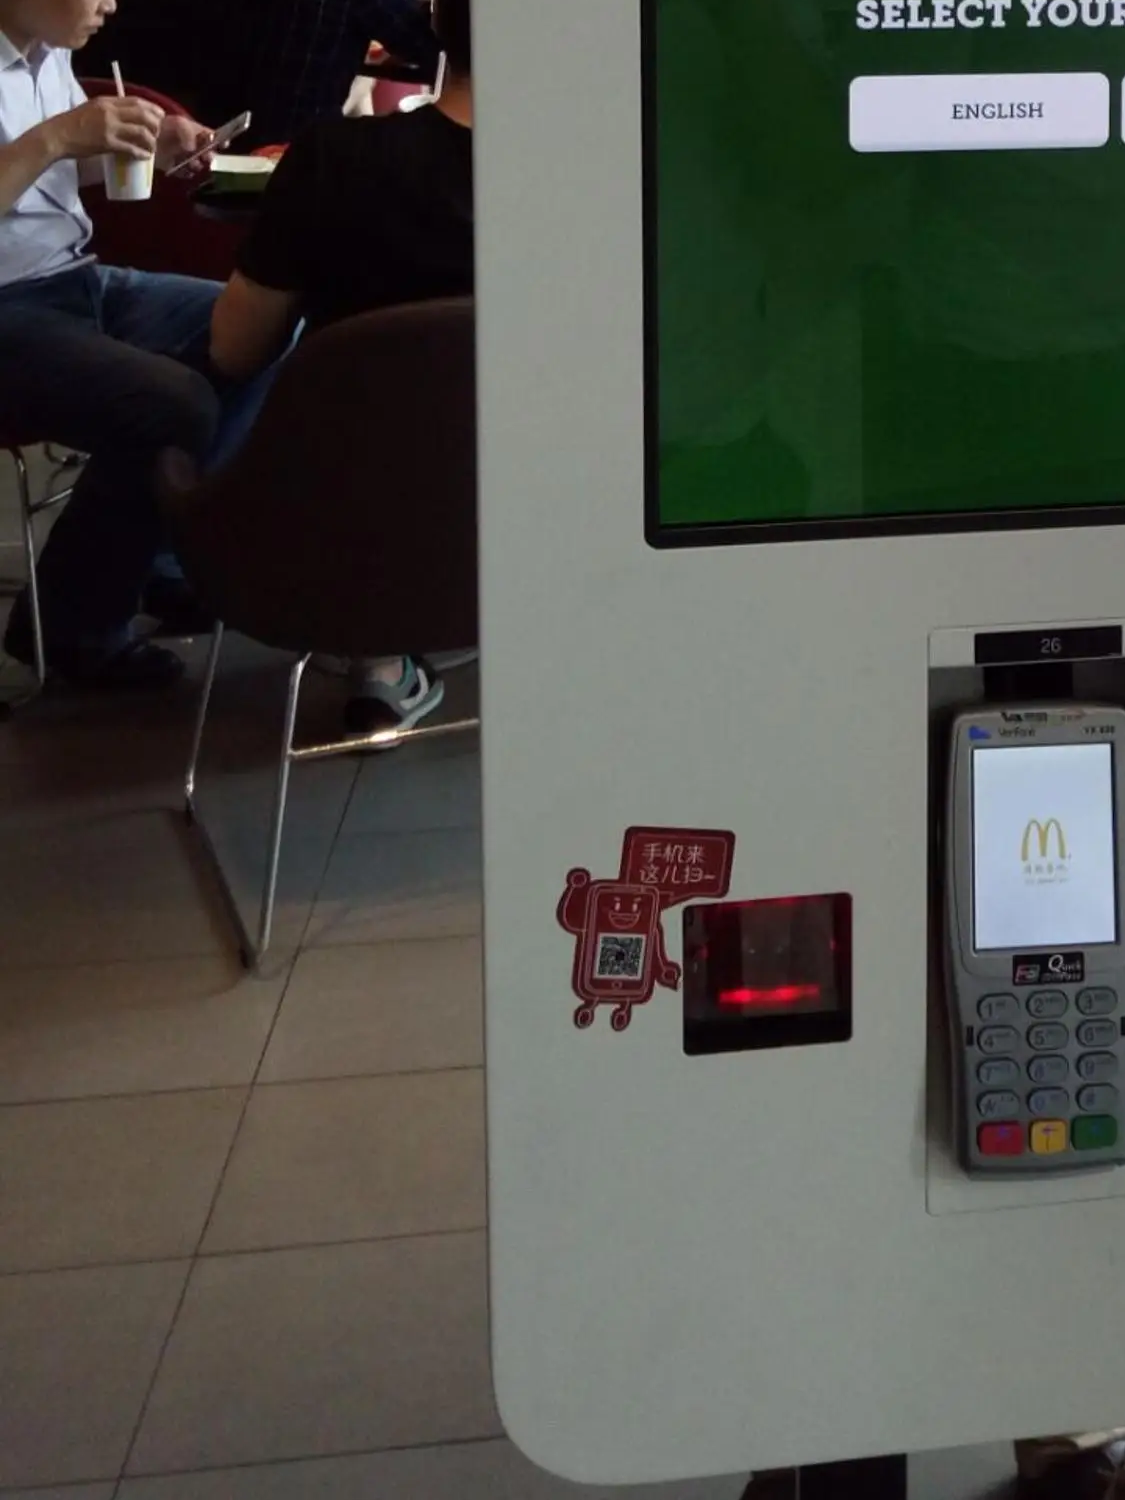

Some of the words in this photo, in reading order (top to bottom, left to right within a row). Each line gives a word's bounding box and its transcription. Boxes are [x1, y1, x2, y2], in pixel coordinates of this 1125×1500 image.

[951, 102, 1044, 120] ENGLISH
[1040, 638, 1062, 654] 26
[641, 842, 705, 864] 手机来
[1034, 999, 1044, 1013] 2
[1034, 1030, 1045, 1045] 5
